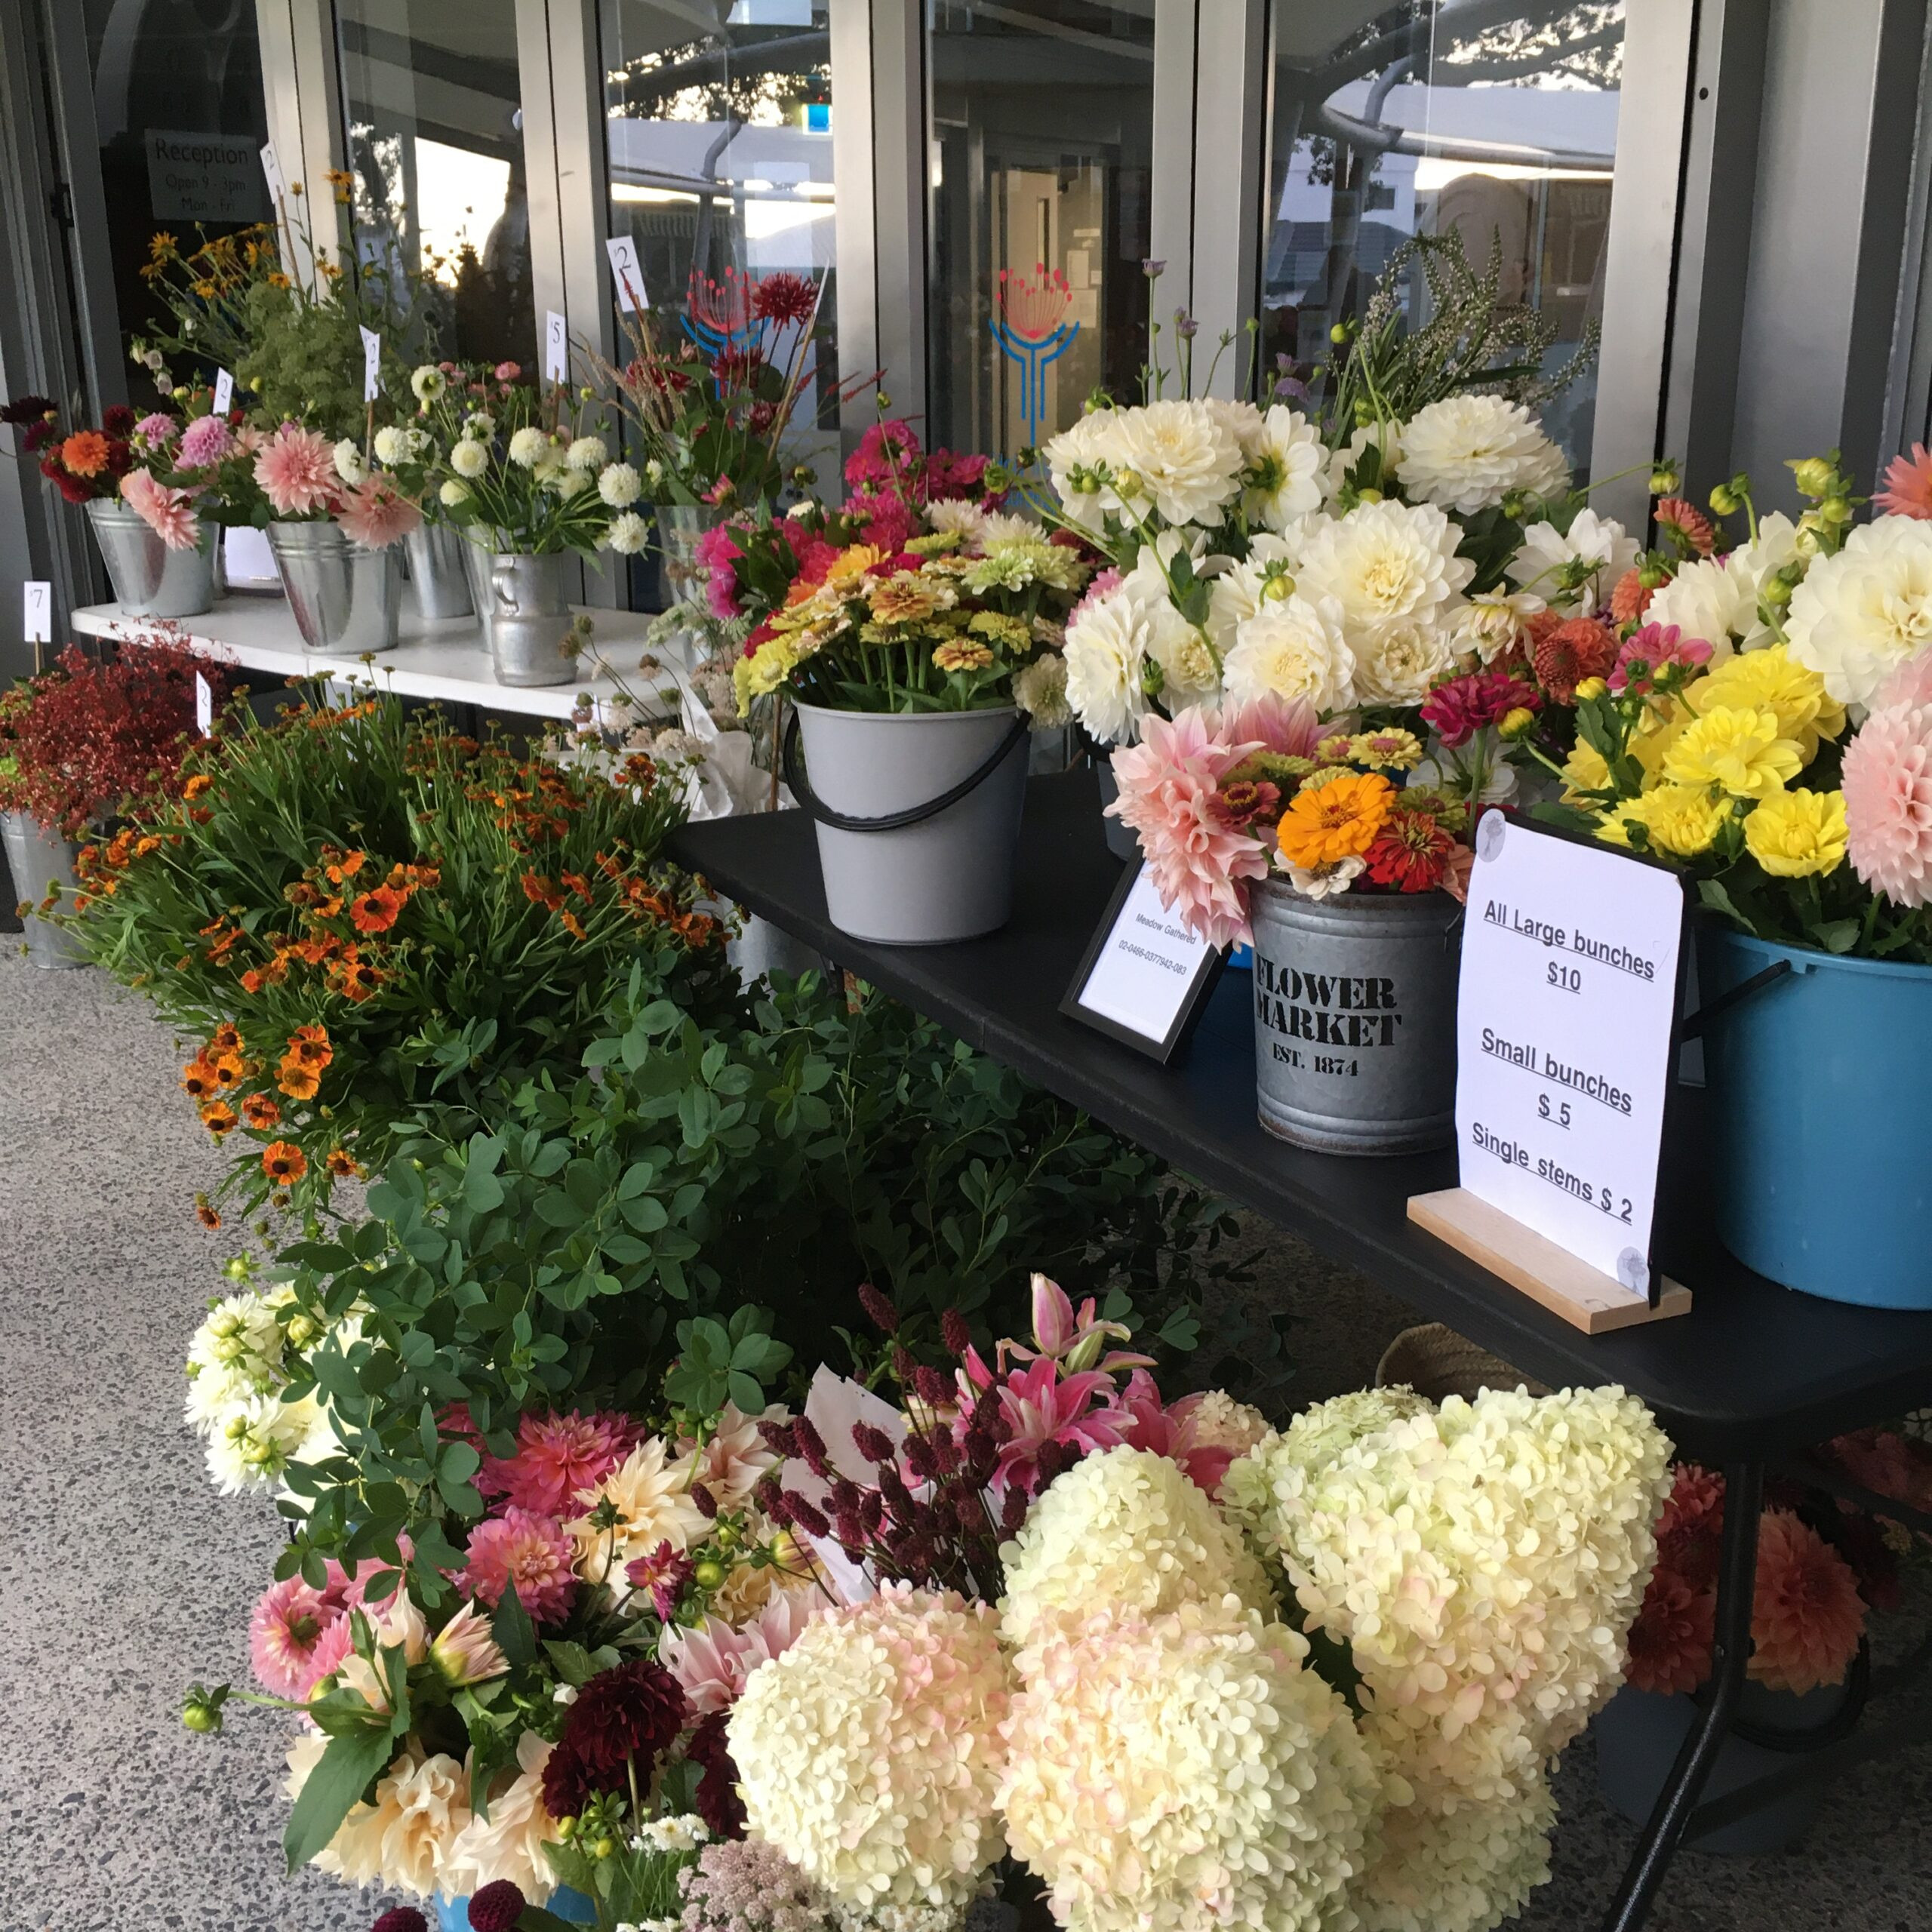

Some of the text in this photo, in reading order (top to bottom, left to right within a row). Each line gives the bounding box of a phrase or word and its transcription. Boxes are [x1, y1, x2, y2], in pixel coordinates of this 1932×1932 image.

[155, 137, 248, 170] Reception
[165, 174, 198, 191] Open
[181, 197, 208, 212] Mon
[1135, 912, 1197, 945] Meadow Gathered
[1484, 899, 1655, 980] All Large bunches
[1256, 952, 1398, 1010] FLOWER
[1547, 960, 1581, 992] $10
[1256, 986, 1402, 1047] MARKET
[1272, 1042, 1359, 1077] EST. 1874
[1481, 1027, 1632, 1113] Small bunches
[1472, 1121, 1530, 1164] Single
[1537, 1158, 1593, 1201] stems
